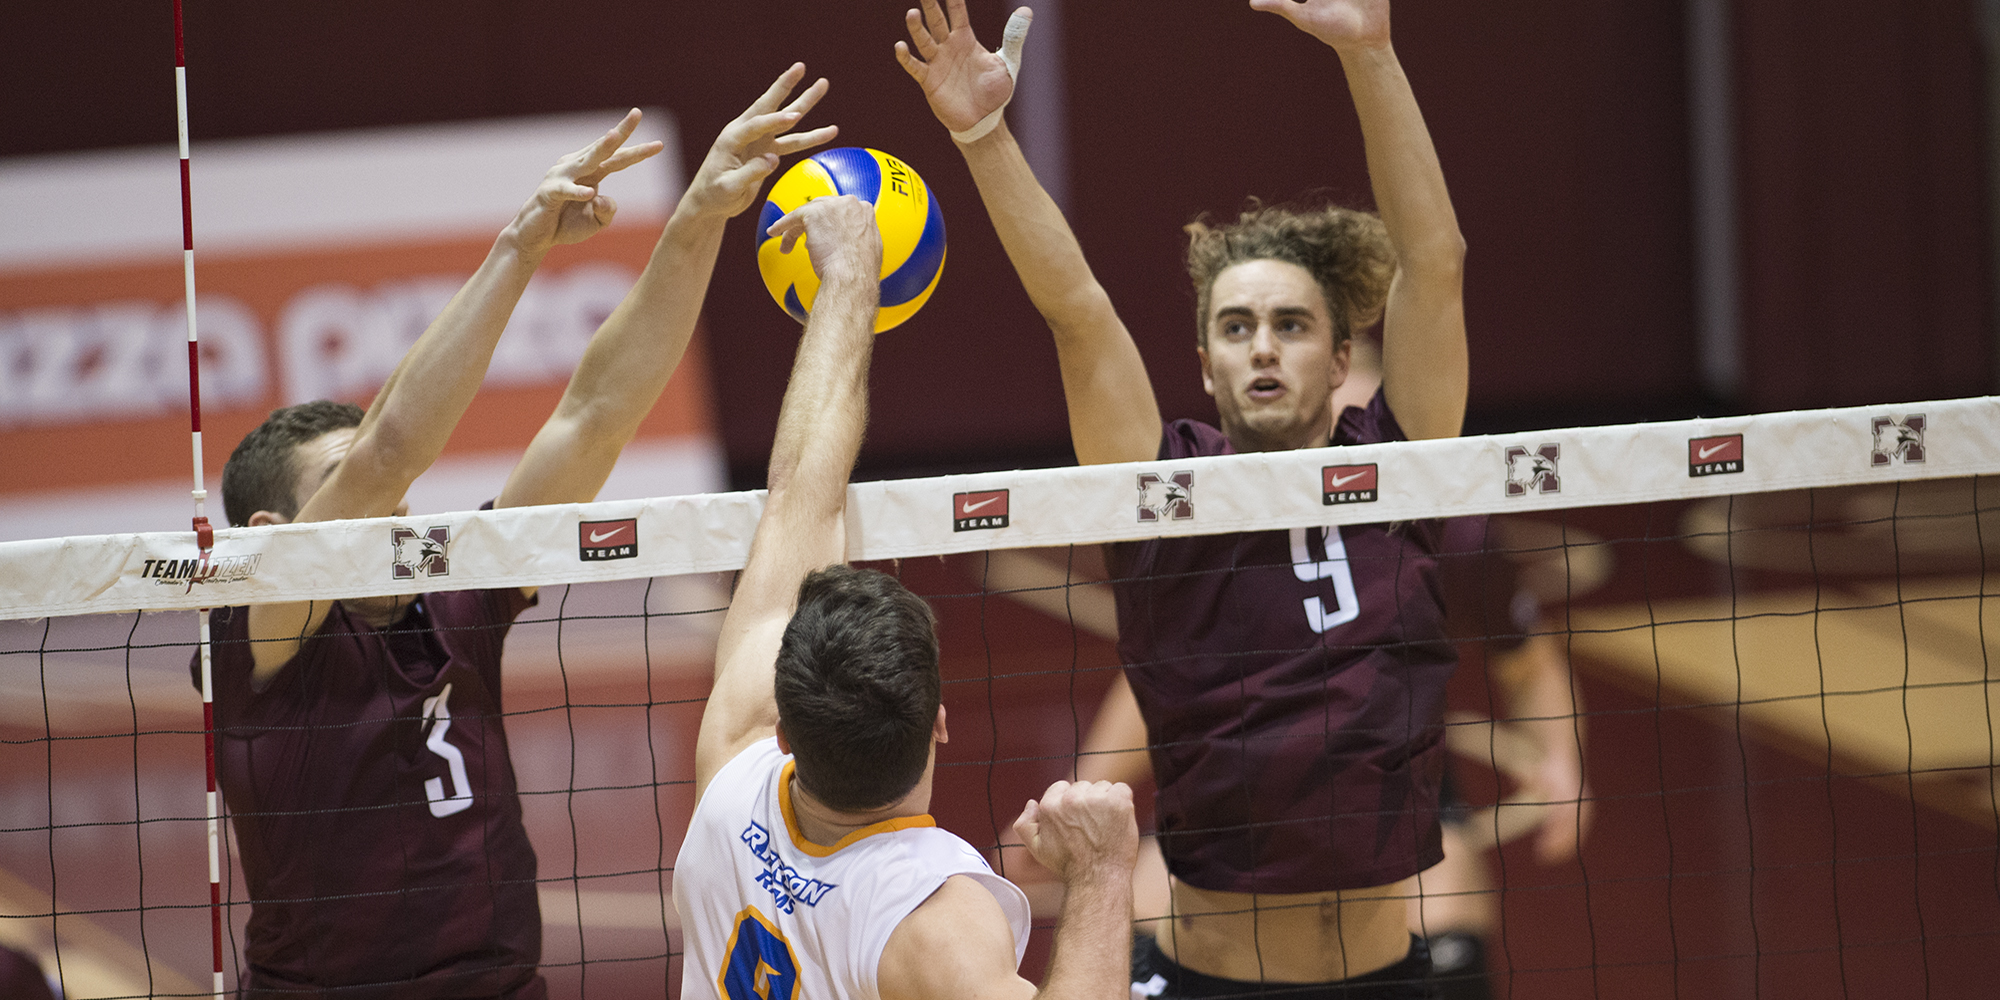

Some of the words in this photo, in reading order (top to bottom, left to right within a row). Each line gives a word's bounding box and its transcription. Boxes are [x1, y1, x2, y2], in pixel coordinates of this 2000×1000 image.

[1695, 462, 1737, 475] TEAM
[1329, 492, 1371, 502] TEAM
[960, 517, 1002, 529] TEAM
[586, 546, 630, 558] TEAM
[1289, 525, 1360, 634] 9
[420, 682, 474, 819] 3
